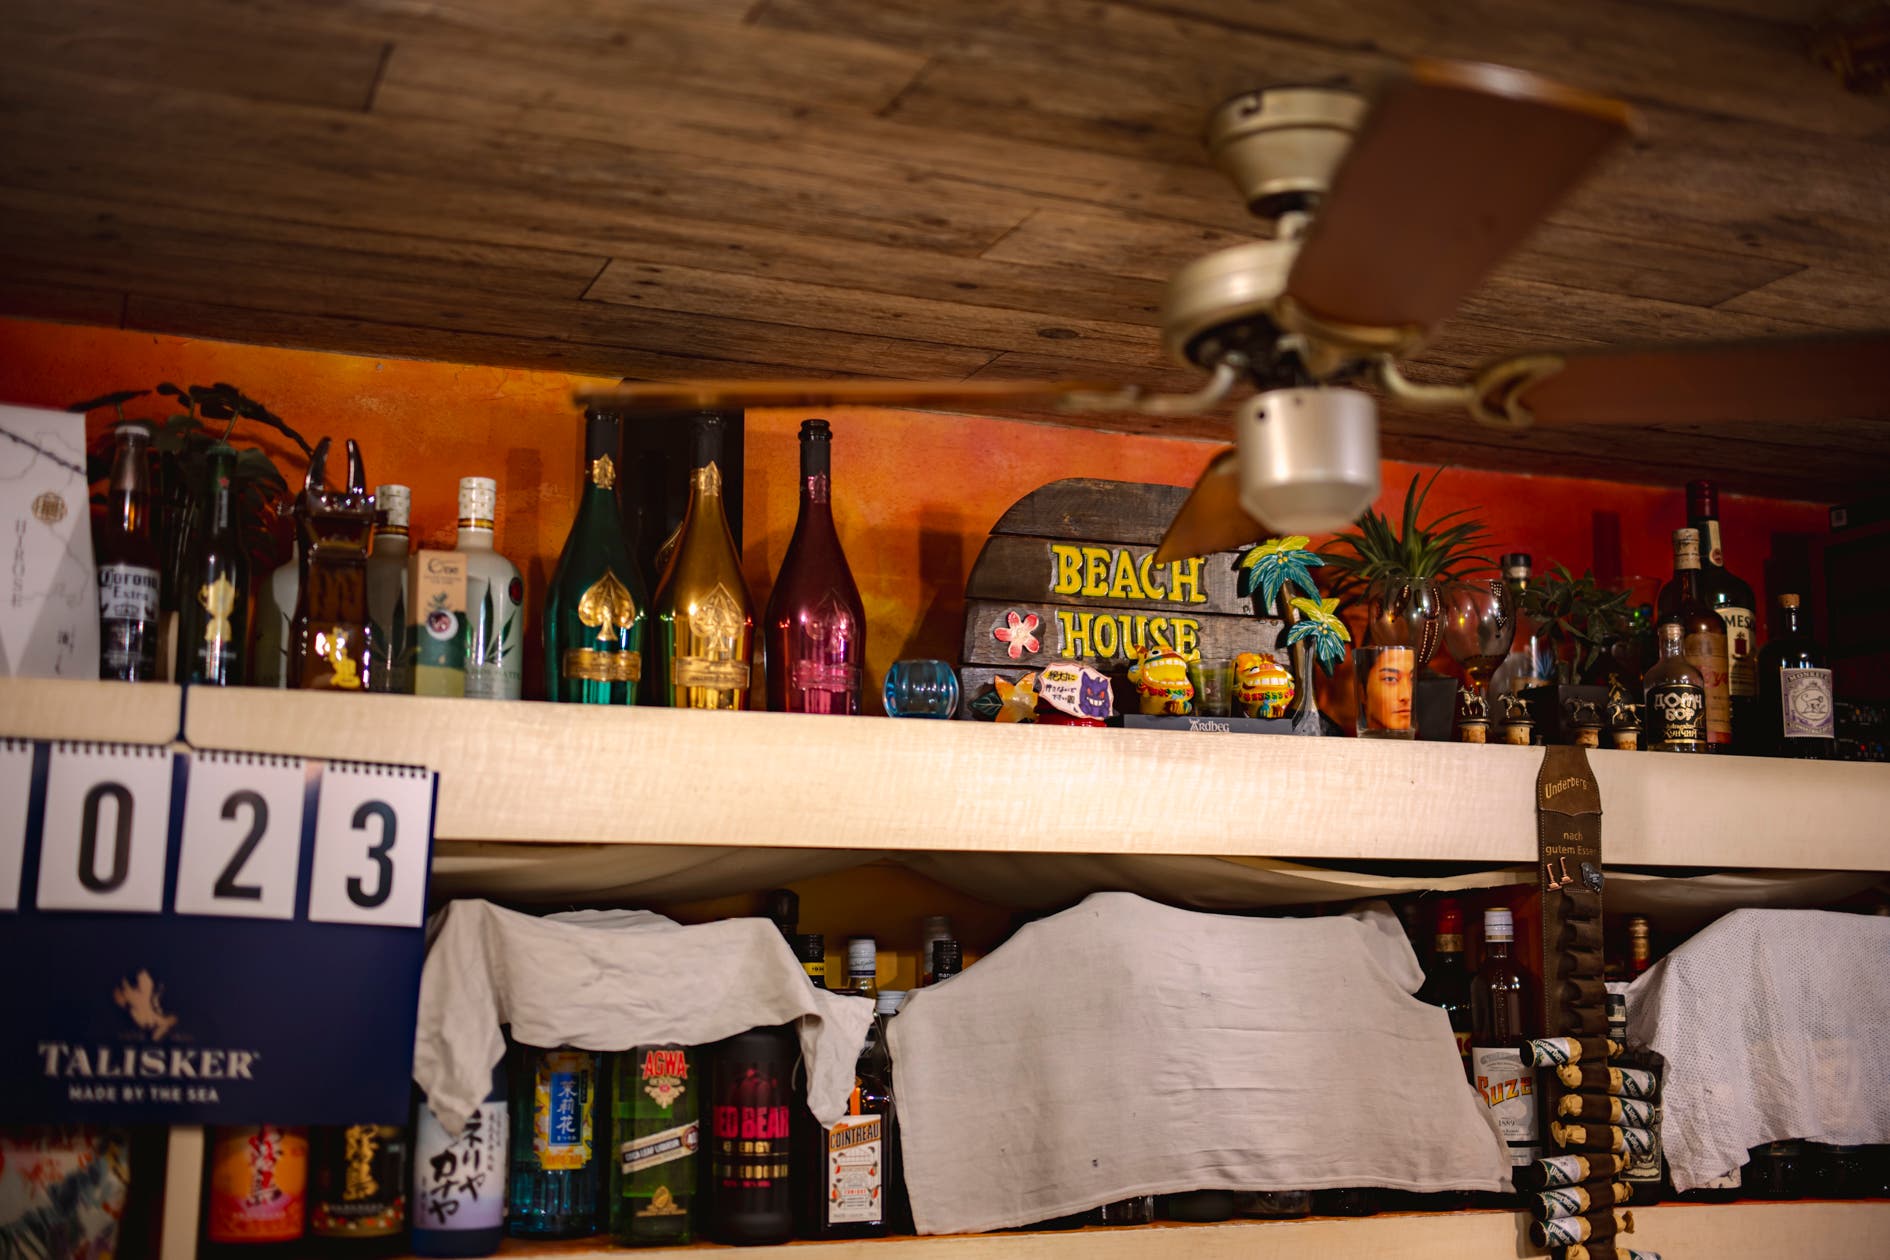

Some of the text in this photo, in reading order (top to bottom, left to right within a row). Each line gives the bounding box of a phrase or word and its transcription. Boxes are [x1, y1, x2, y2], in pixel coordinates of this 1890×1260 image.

[1052, 545, 1206, 602] BEACH
[1058, 611, 1200, 660] HOUSE
[1545, 777, 1588, 799] Underberg
[1563, 831, 1584, 841] nach
[1545, 845, 1576, 856] gutem
[37, 1040, 256, 1080] TALISKER
[642, 1050, 688, 1080] AGWA
[68, 1084, 220, 1103] MADE BY THE SEA
[1477, 1076, 1533, 1109] Suze
[830, 1122, 879, 1149] COINTREAU
